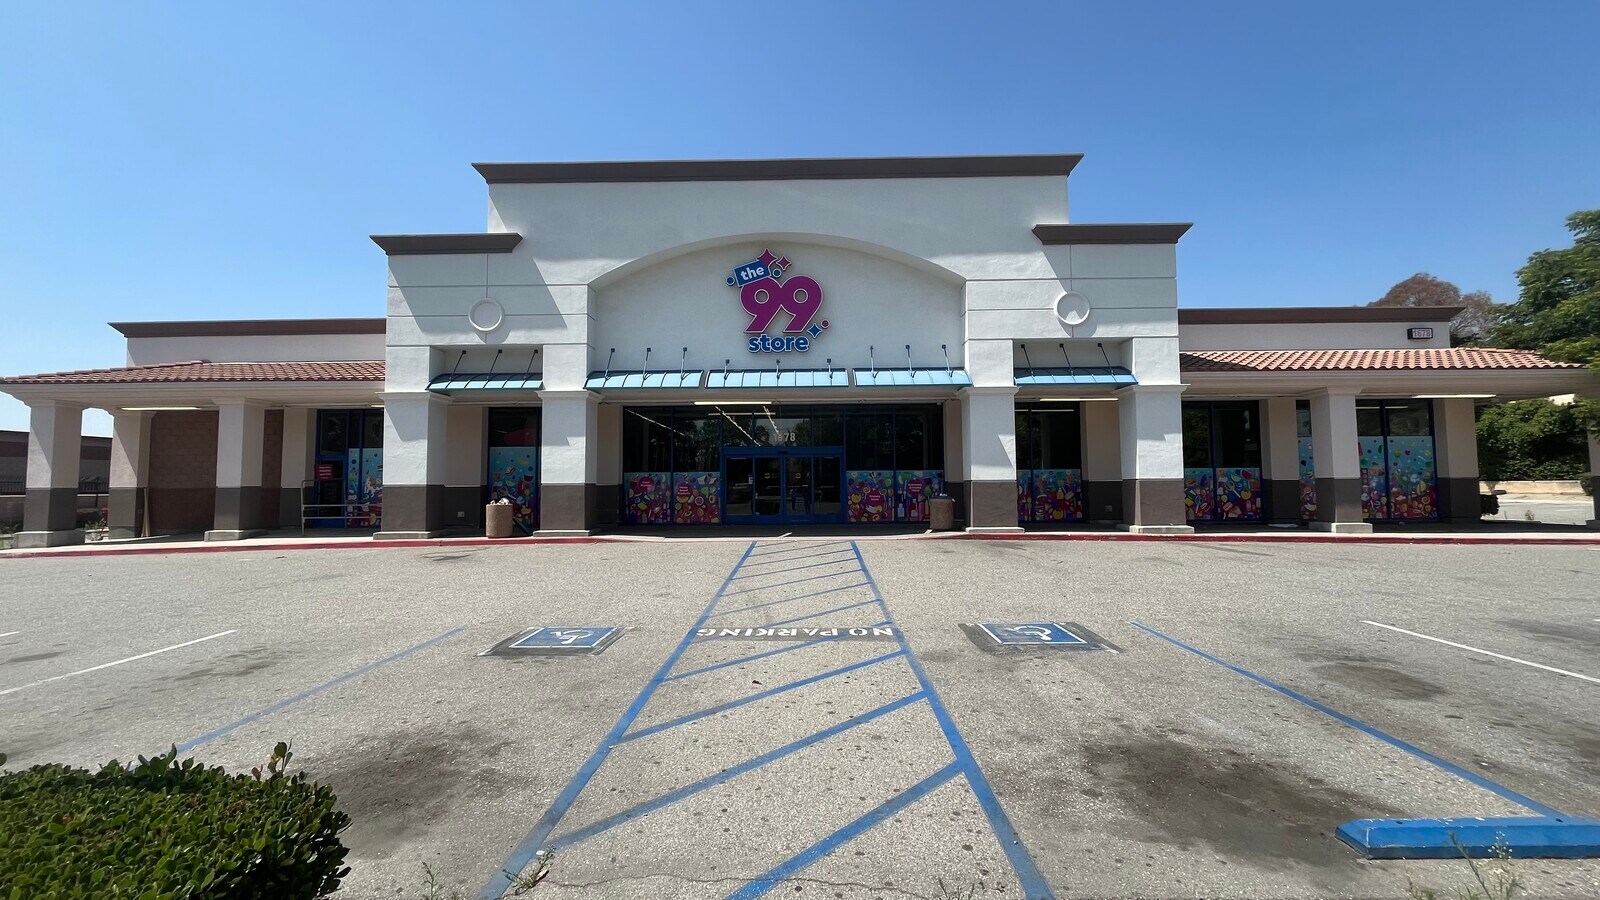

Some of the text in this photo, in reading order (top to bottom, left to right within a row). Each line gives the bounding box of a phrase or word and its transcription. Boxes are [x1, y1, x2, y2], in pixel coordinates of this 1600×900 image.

[740, 267, 764, 280] the
[740, 275, 823, 333] 99
[748, 334, 809, 352] store
[773, 432, 796, 441] 1678
[696, 627, 894, 636] NO PARKING
